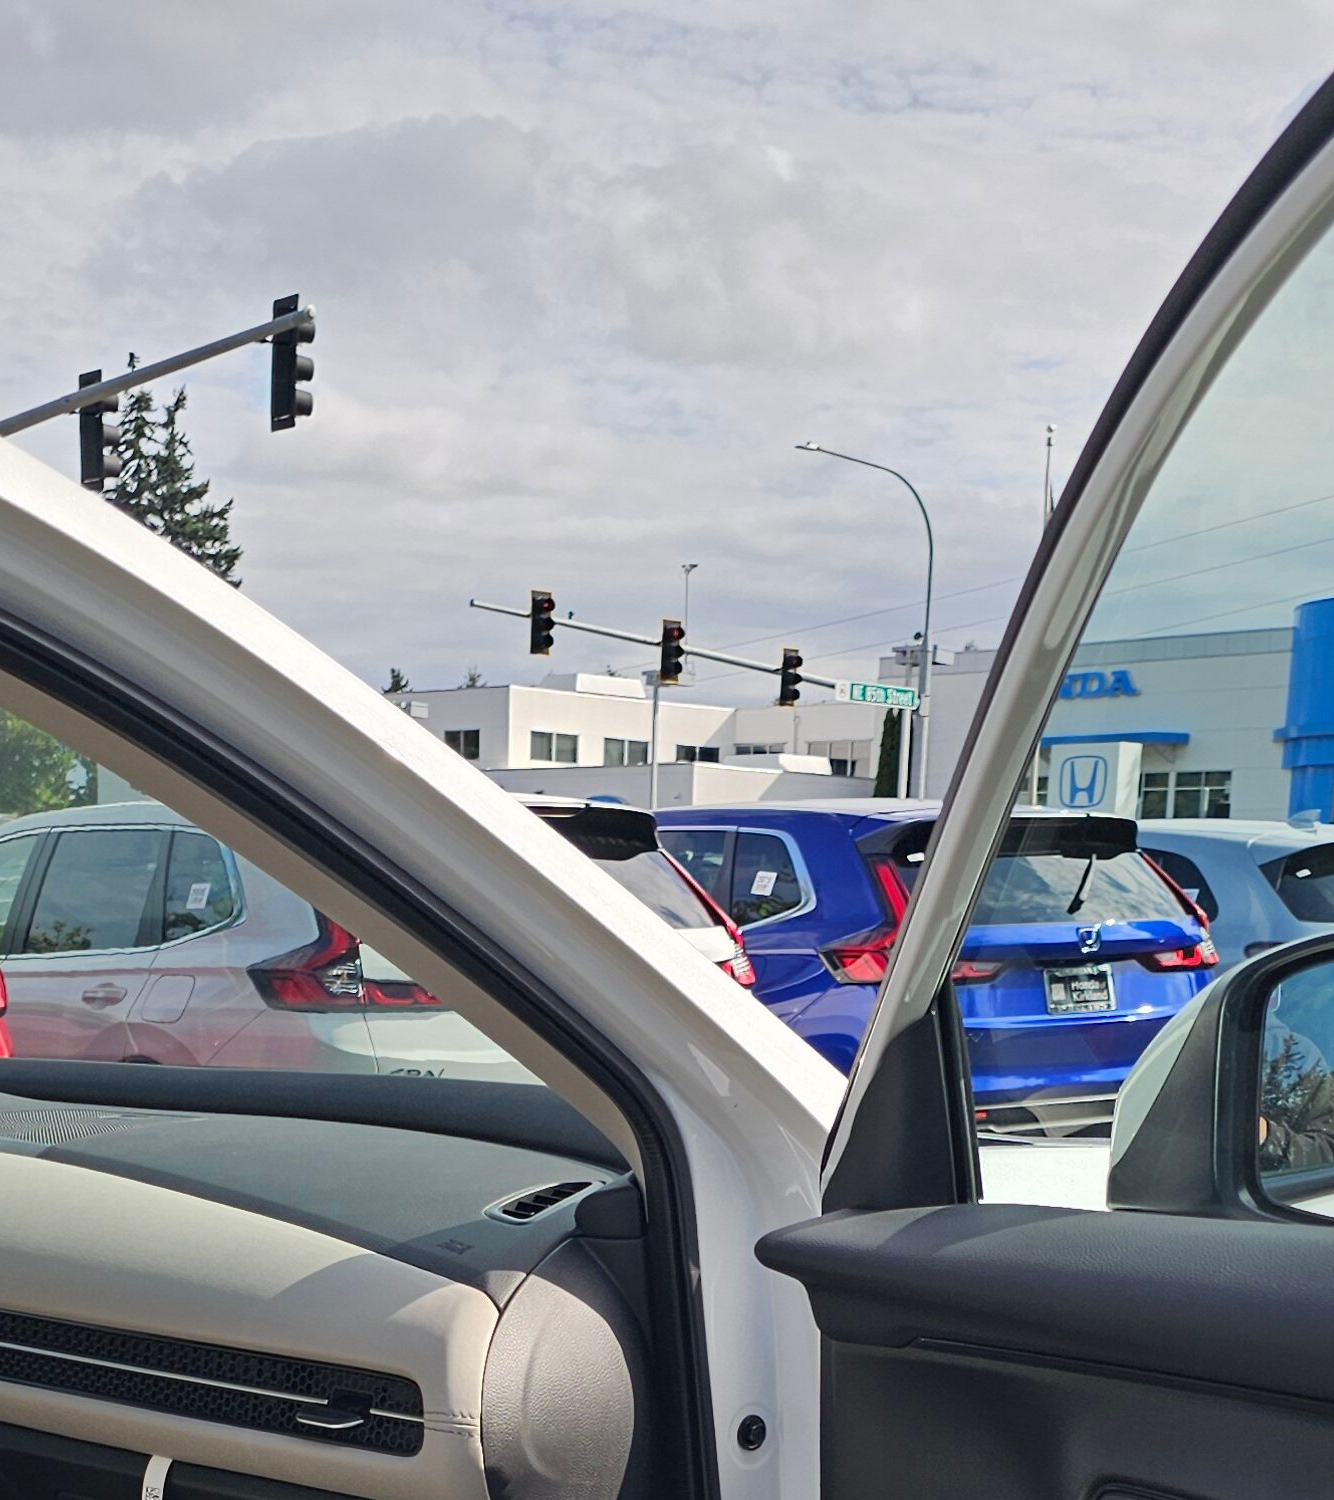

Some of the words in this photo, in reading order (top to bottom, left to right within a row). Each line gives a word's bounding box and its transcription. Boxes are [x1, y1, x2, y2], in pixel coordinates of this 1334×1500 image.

[852, 684, 864, 700] NE
[887, 688, 914, 706] Street
[1059, 669, 1138, 699] NDA
